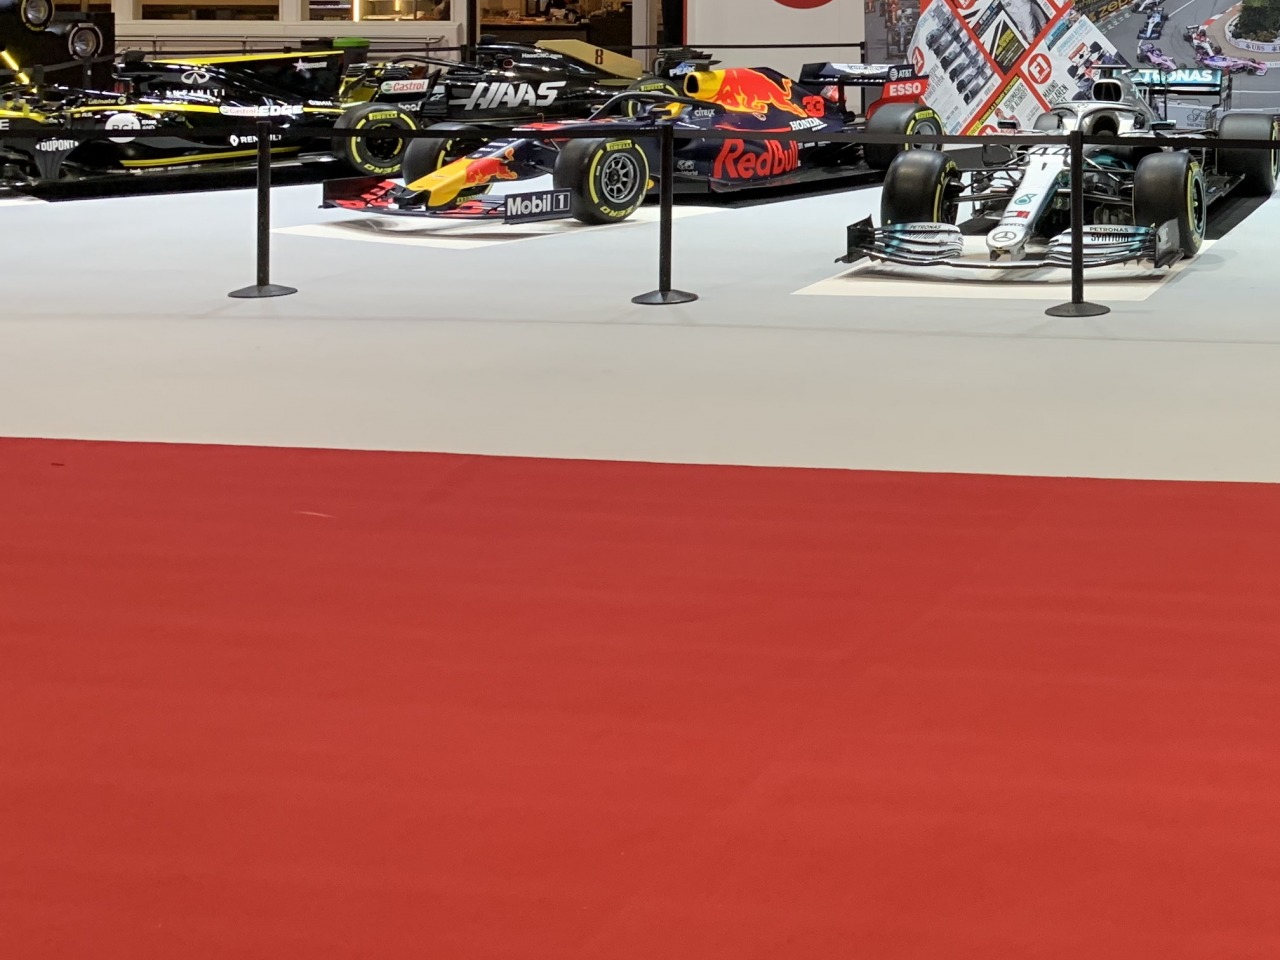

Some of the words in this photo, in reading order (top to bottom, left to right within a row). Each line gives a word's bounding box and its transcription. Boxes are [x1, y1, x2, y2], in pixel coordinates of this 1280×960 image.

[594, 49, 604, 65] 8
[898, 69, 913, 78] AT&T
[1030, 55, 1051, 80] F1
[1122, 69, 1213, 82] TRONAS
[393, 81, 425, 92] Castrol
[889, 82, 922, 97] ESSO
[449, 81, 567, 111] HAAS
[259, 105, 304, 116] EDGE
[802, 95, 825, 118] 33
[789, 117, 824, 132] HONDA
[41, 139, 74, 152] DUPONT
[606, 140, 633, 152] PIRELLI
[364, 163, 402, 175] ZERO
[507, 194, 552, 217] Mobil
[601, 204, 634, 218] ZERO
